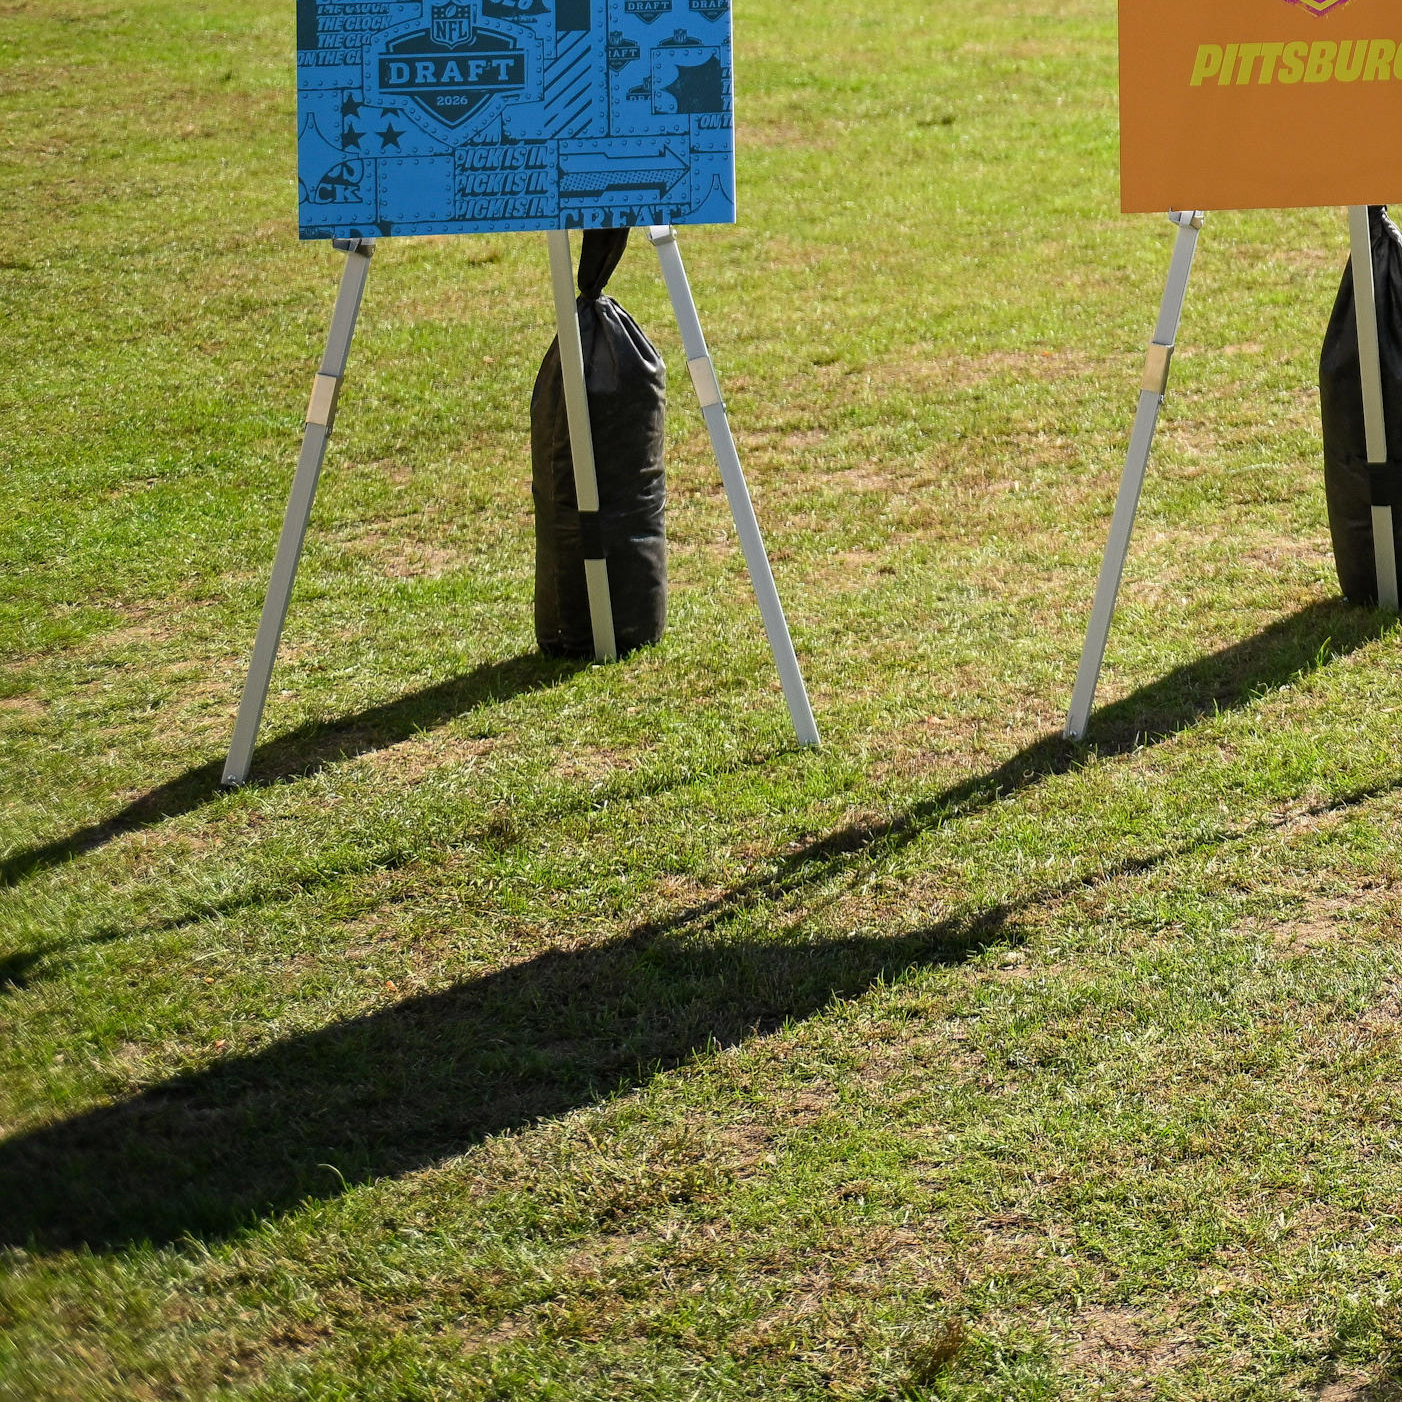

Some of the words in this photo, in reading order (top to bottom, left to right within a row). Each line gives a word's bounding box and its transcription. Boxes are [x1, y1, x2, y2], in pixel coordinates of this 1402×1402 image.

[628, 1, 670, 11] DRAFT
[317, 16, 343, 32] THE
[435, 20, 468, 43] NFL
[317, 33, 343, 48] THE
[316, 50, 343, 66] THE
[389, 59, 515, 85] DRAFT
[436, 95, 468, 106] 2026
[455, 147, 501, 172] PICK
[455, 172, 502, 197] PICK
